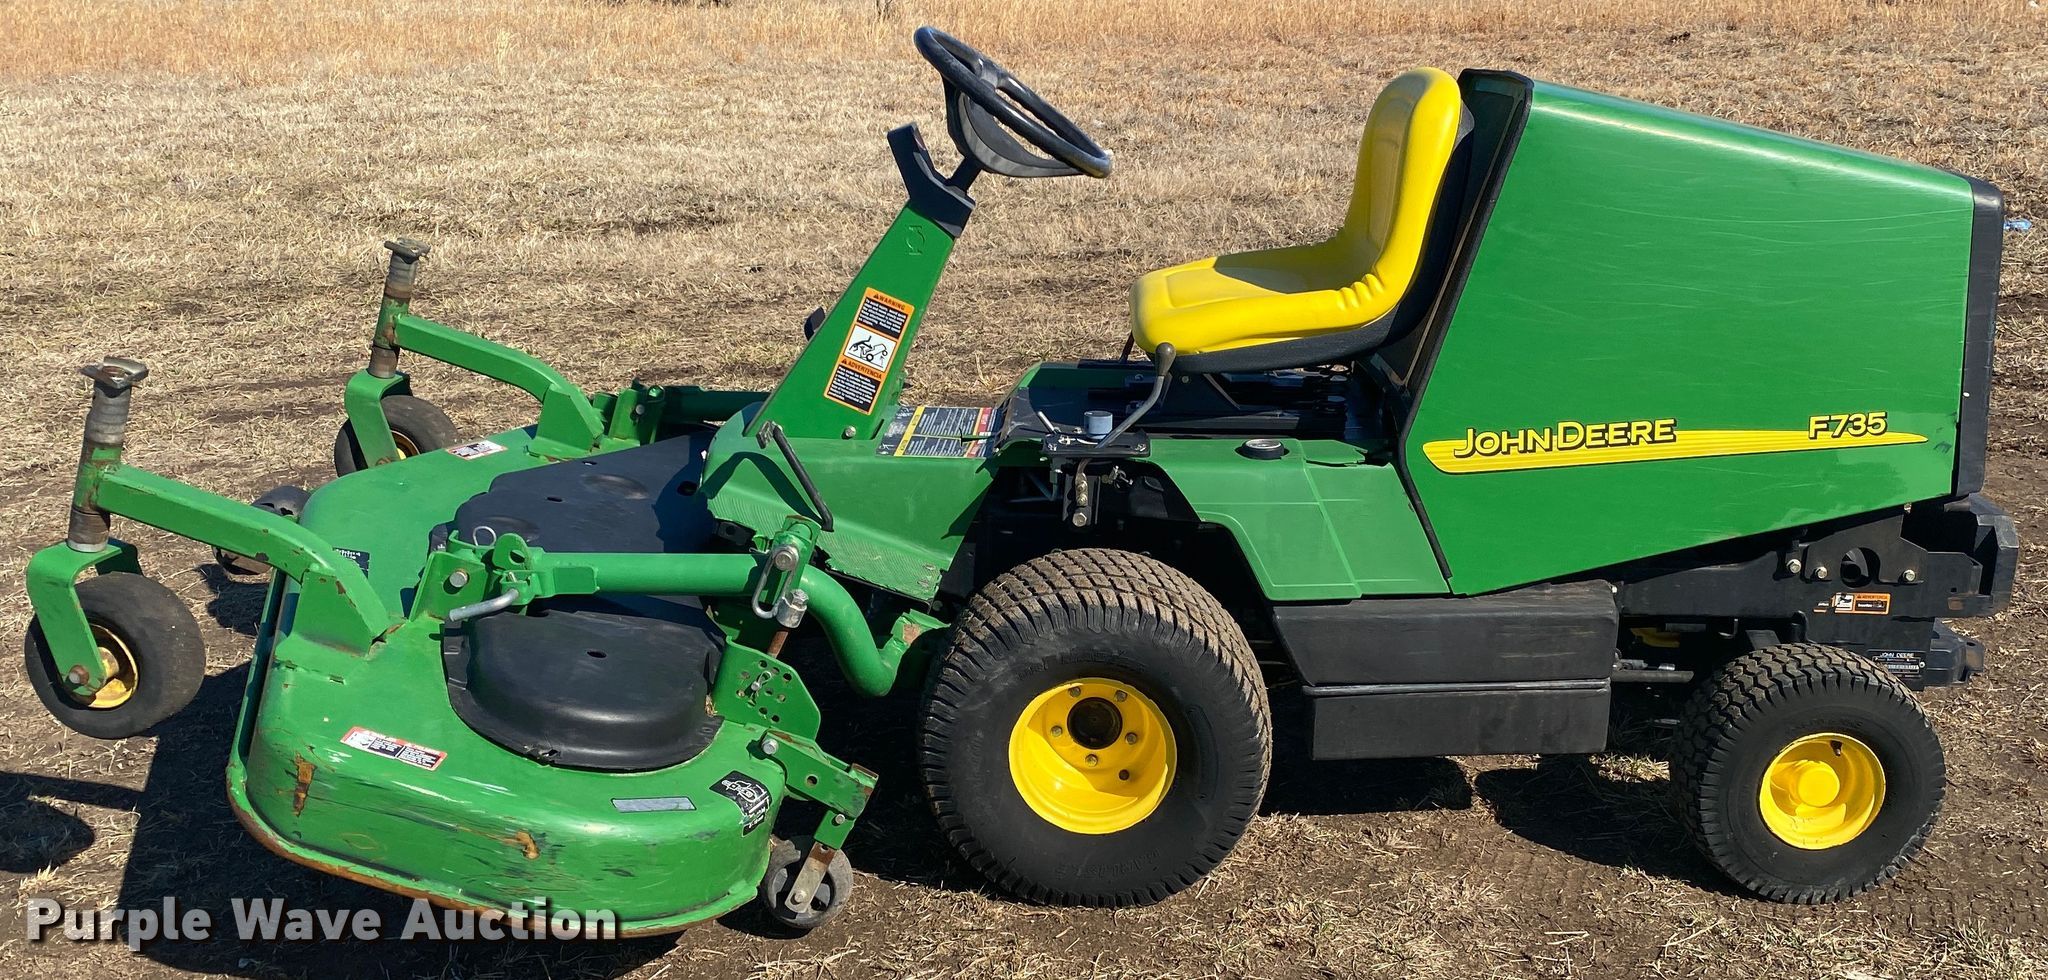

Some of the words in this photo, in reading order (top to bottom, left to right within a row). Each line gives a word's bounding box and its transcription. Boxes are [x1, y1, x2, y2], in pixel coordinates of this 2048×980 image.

[879, 296, 905, 311] WARNING
[847, 361, 882, 380] ADVERTENCIA
[1808, 412, 1888, 438] F735
[1454, 427, 1553, 458] JOHN
[1557, 418, 1677, 450] DEERE
